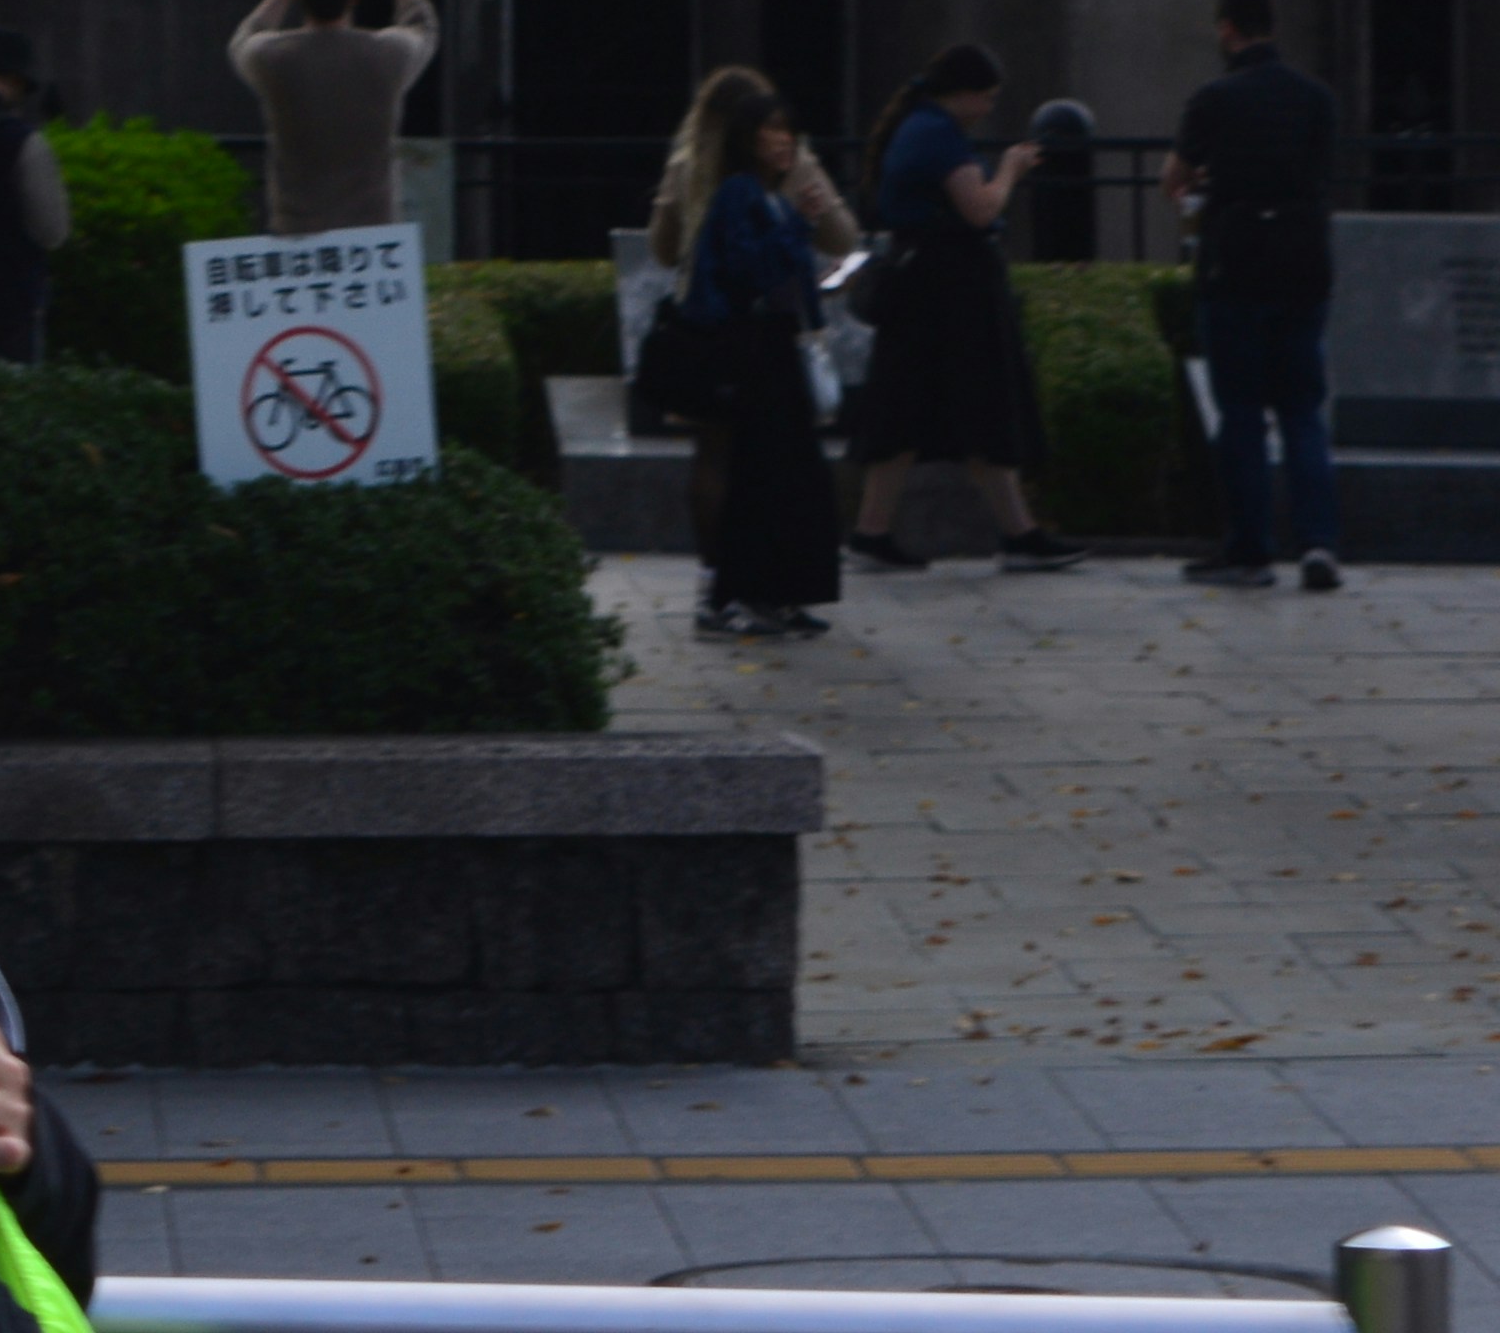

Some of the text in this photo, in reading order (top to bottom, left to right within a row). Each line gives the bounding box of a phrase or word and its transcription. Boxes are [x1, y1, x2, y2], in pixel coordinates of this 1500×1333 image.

[205, 241, 402, 286] 自転車は降りて
[208, 278, 406, 323] 押して下さい
